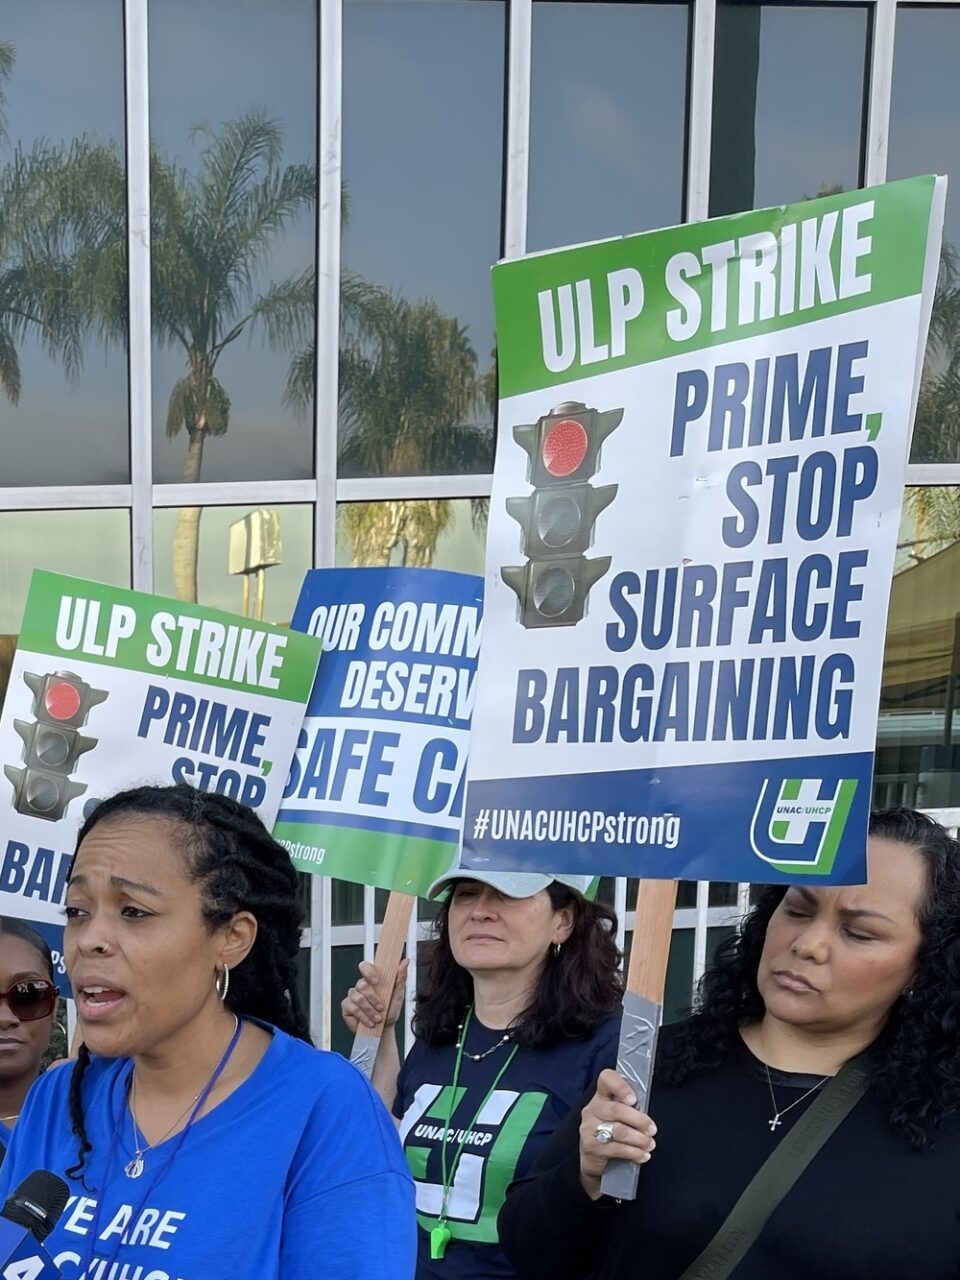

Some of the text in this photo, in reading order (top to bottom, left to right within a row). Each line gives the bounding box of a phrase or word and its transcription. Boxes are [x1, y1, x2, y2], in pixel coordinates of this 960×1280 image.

[536, 199, 875, 374] ULP STRIKE
[669, 339, 883, 459] PRIME,
[720, 445, 879, 549] STOP
[55, 595, 288, 690] ULP STRIKE
[307, 603, 366, 652] OUR
[605, 549, 869, 654] SURFACE
[137, 684, 274, 777] PRIME,
[511, 652, 857, 745] BARGAINING
[472, 807, 681, 850] #UNACUHCPstrong
[414, 1123, 493, 1147] UNAC/UHCP
[99, 1204, 187, 1250] ARE
